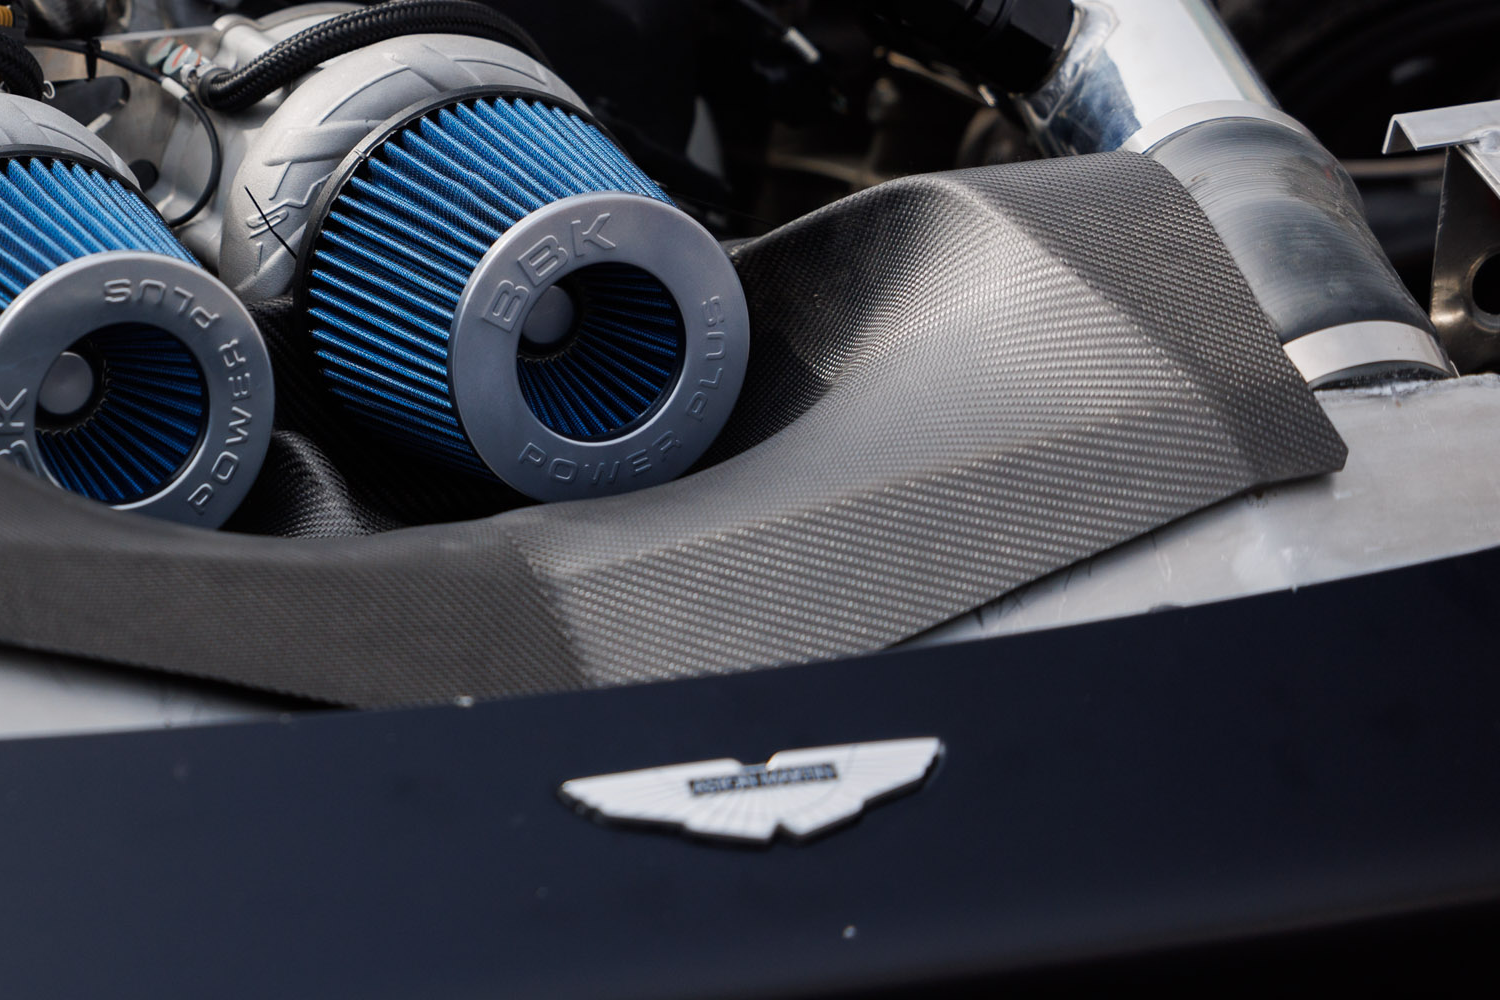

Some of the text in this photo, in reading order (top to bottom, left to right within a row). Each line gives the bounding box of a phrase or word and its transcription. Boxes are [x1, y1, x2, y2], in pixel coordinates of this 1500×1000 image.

[481, 212, 616, 333] BBK
[103, 278, 253, 515] POWER PLUS
[518, 295, 727, 485] POWER PLUS
